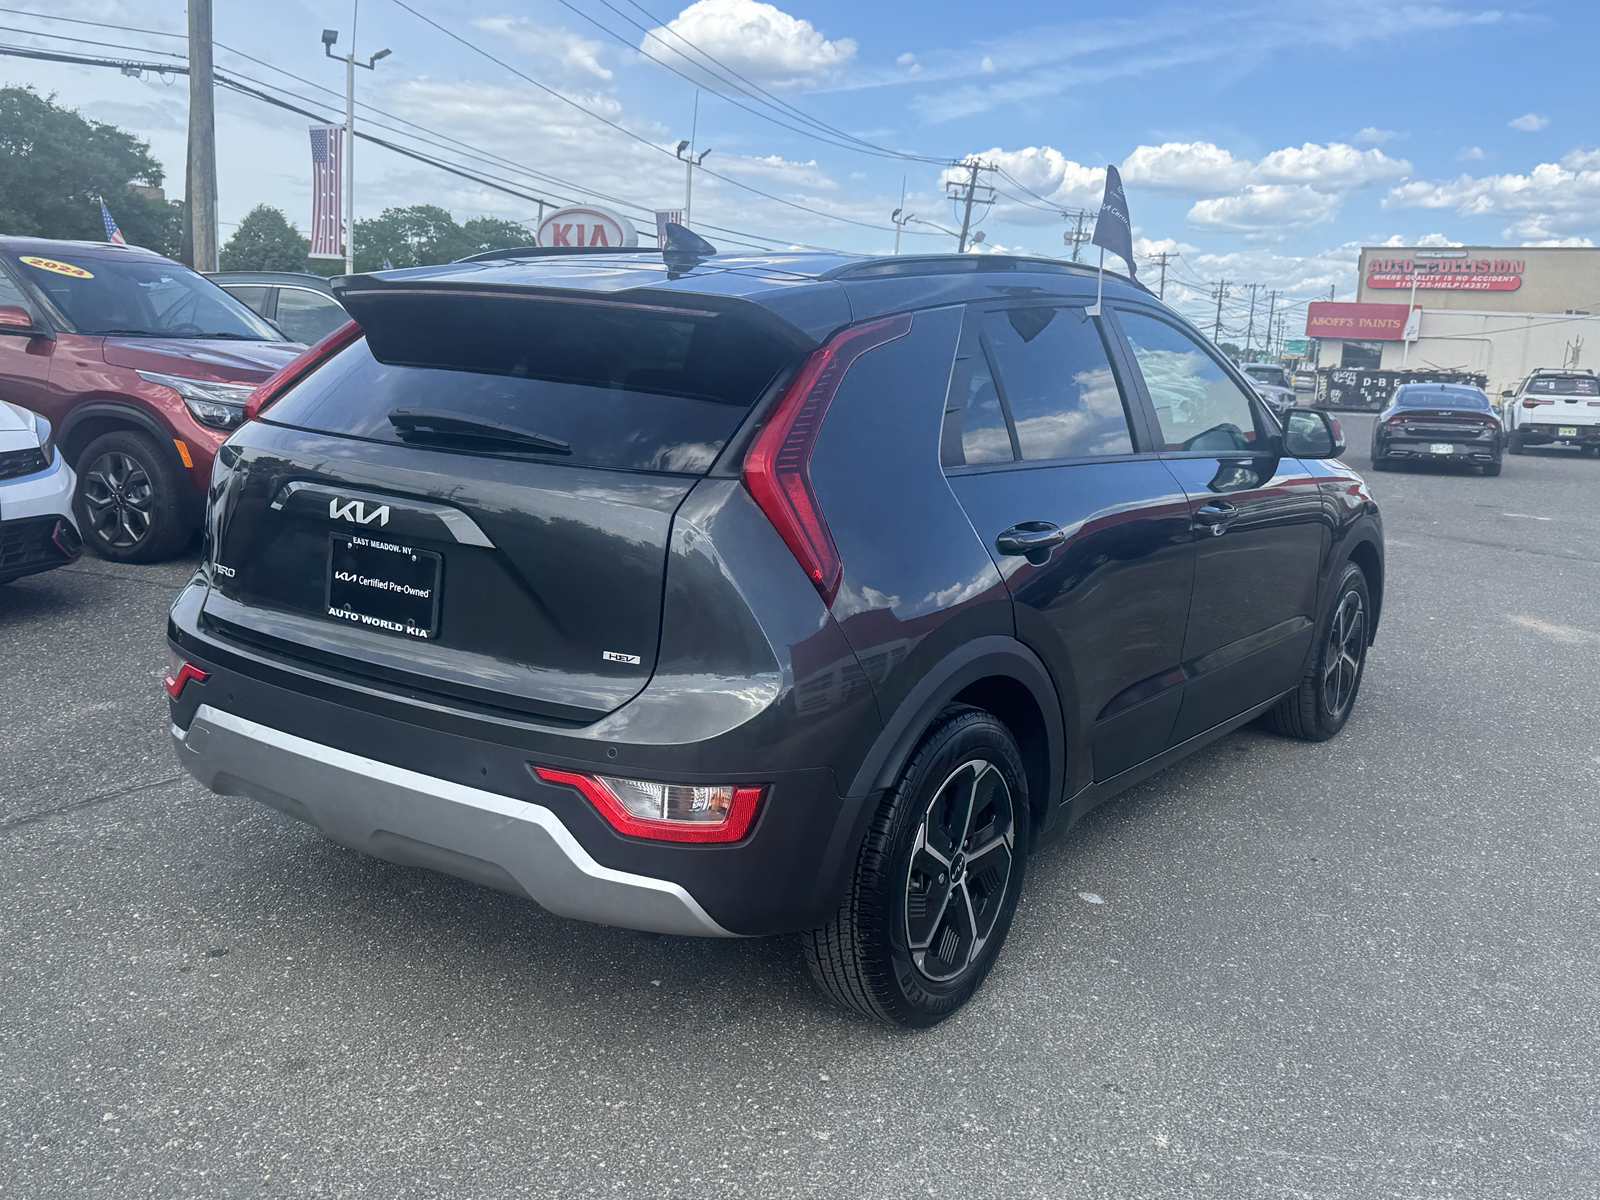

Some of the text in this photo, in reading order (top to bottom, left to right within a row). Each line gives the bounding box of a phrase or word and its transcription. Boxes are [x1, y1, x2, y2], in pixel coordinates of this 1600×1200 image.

[552, 223, 609, 247] KIA
[29, 258, 85, 276] 2024
[1369, 259, 1525, 274] AUTO COLLISION
[1311, 317, 1401, 328] ABOFF'S PAINTS
[329, 497, 390, 527] KIA
[353, 536, 369, 547] EAST
[403, 547, 412, 555] NY
[335, 570, 357, 583] KIA
[359, 575, 388, 590] Certified
[328, 607, 428, 638] AUTO WORLD KIA
[609, 653, 635, 662] HEV
